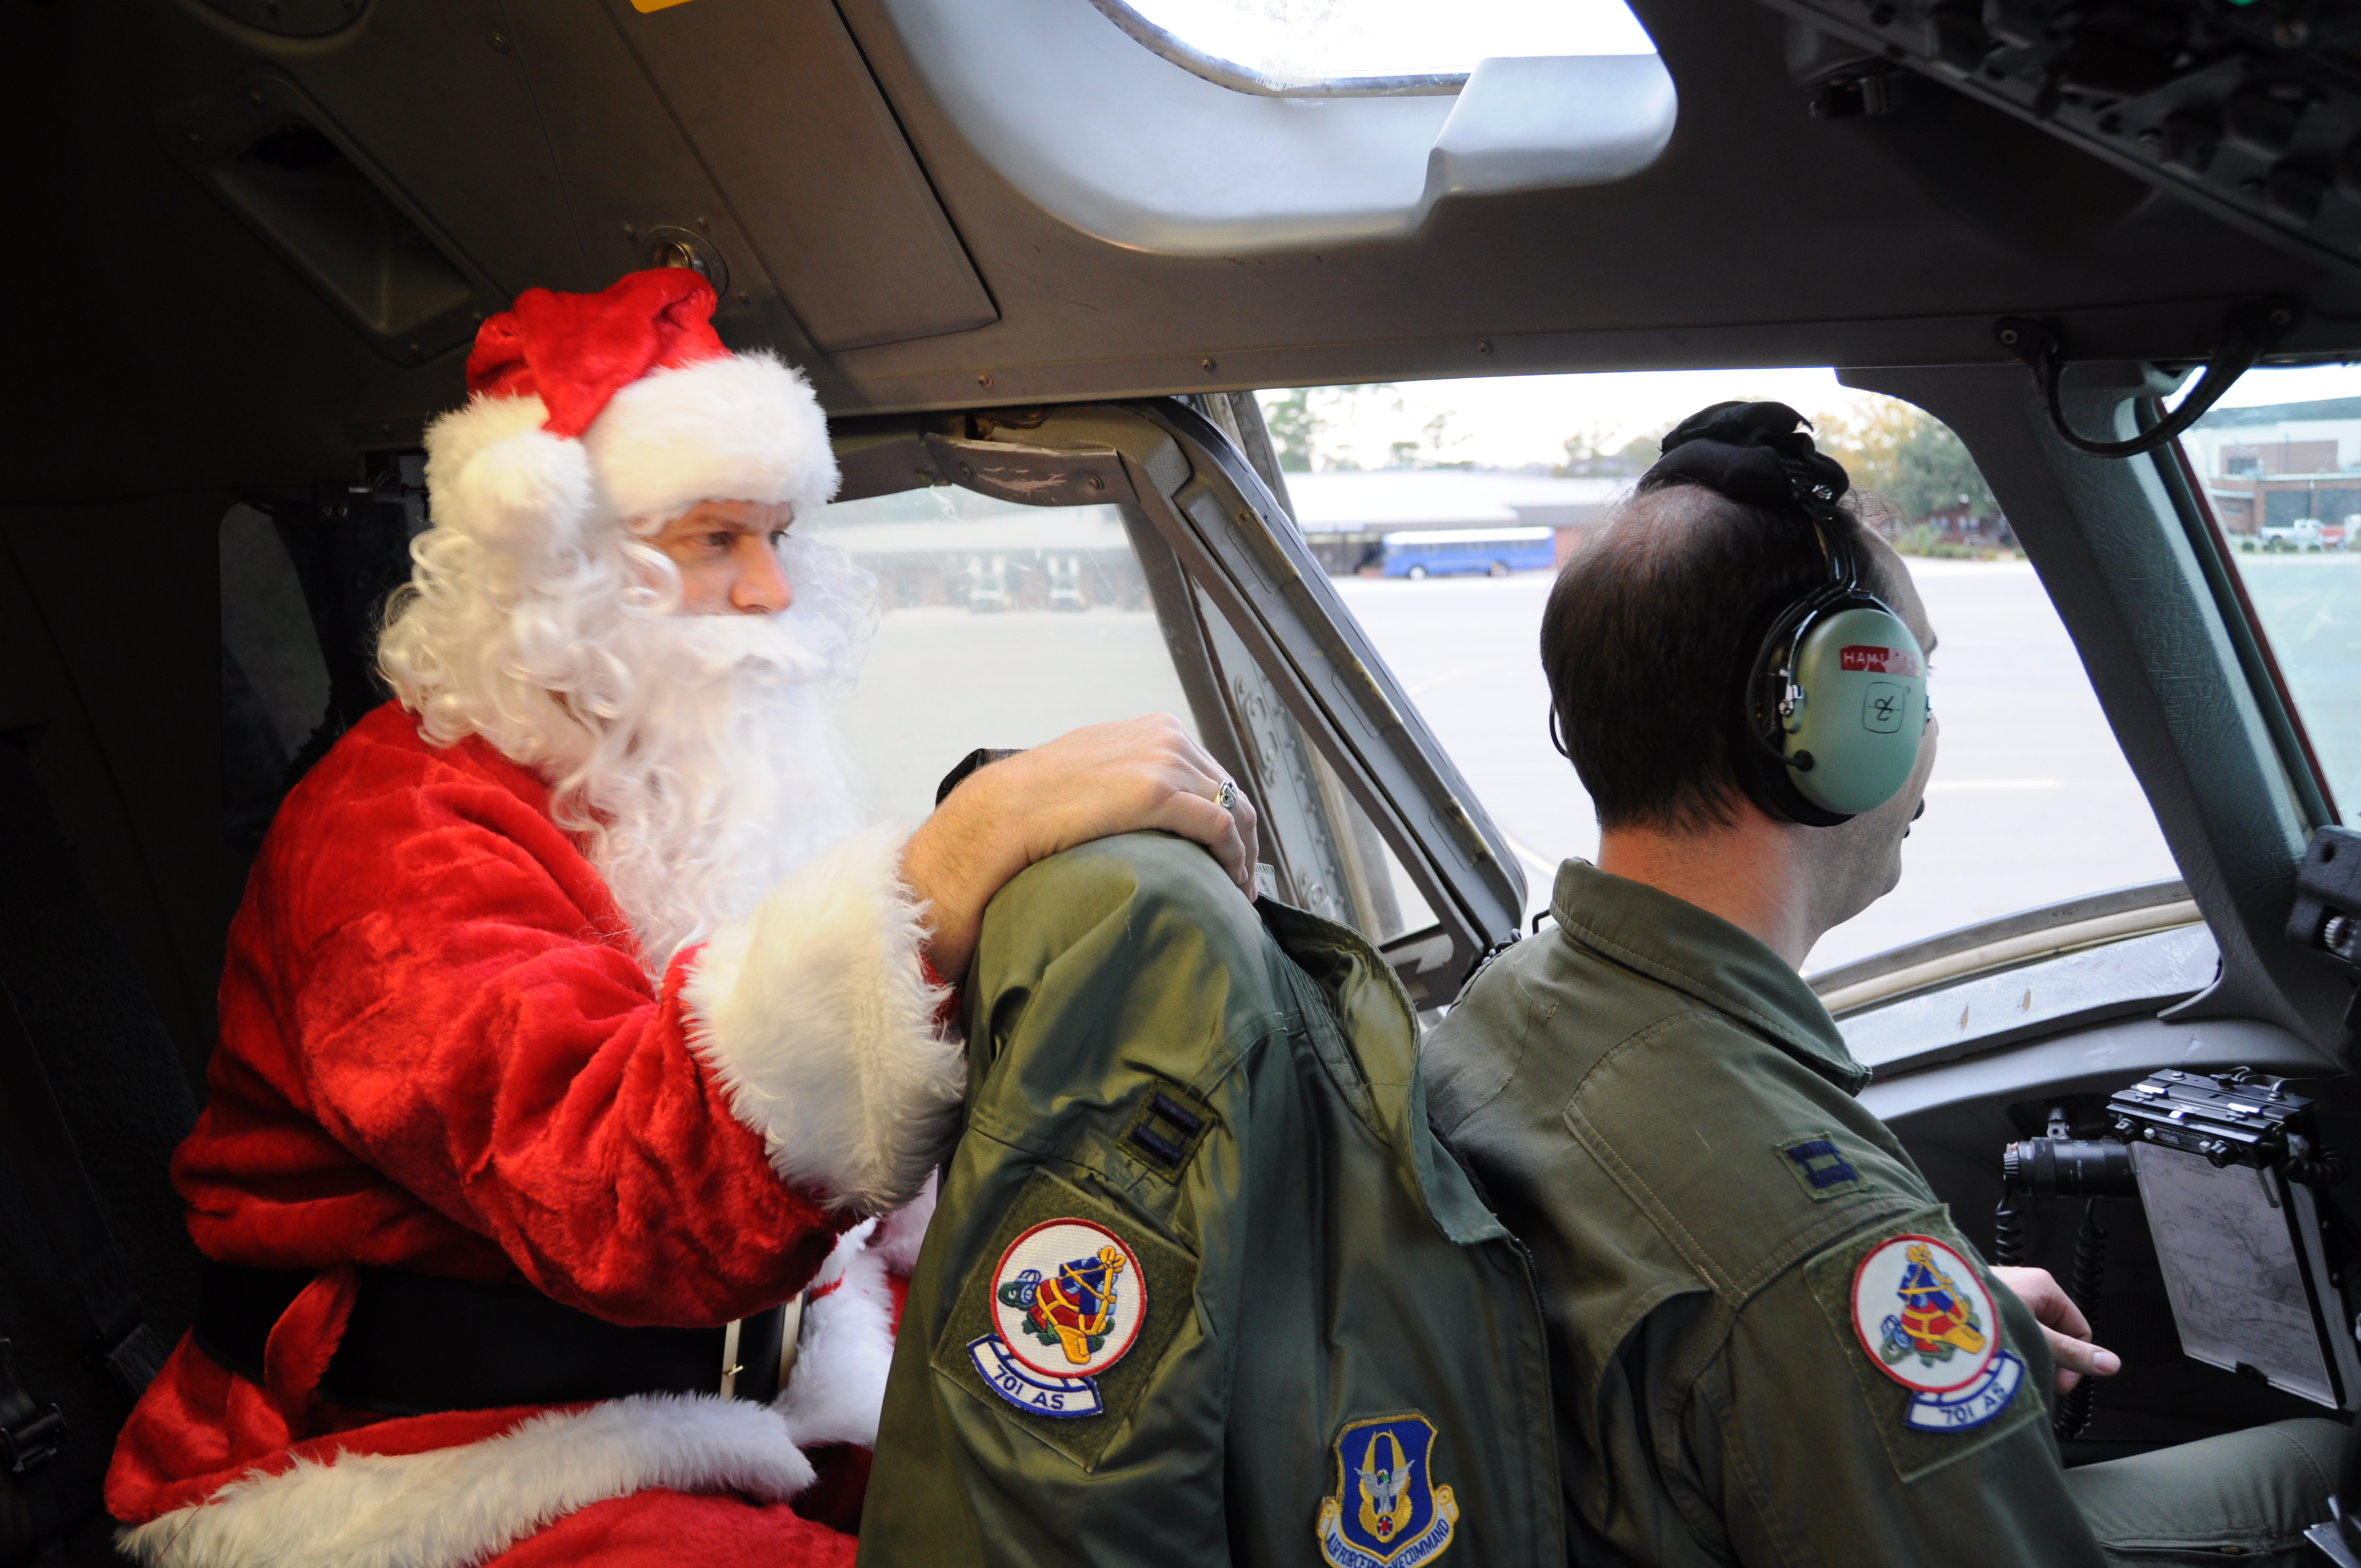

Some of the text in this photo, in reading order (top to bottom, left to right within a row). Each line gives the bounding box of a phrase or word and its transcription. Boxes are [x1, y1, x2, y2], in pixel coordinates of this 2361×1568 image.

[994, 1364, 1064, 1410] 701 AS
[1940, 1380, 2007, 1425] 701 AS
[1405, 1518, 1449, 1565] COMMAND
